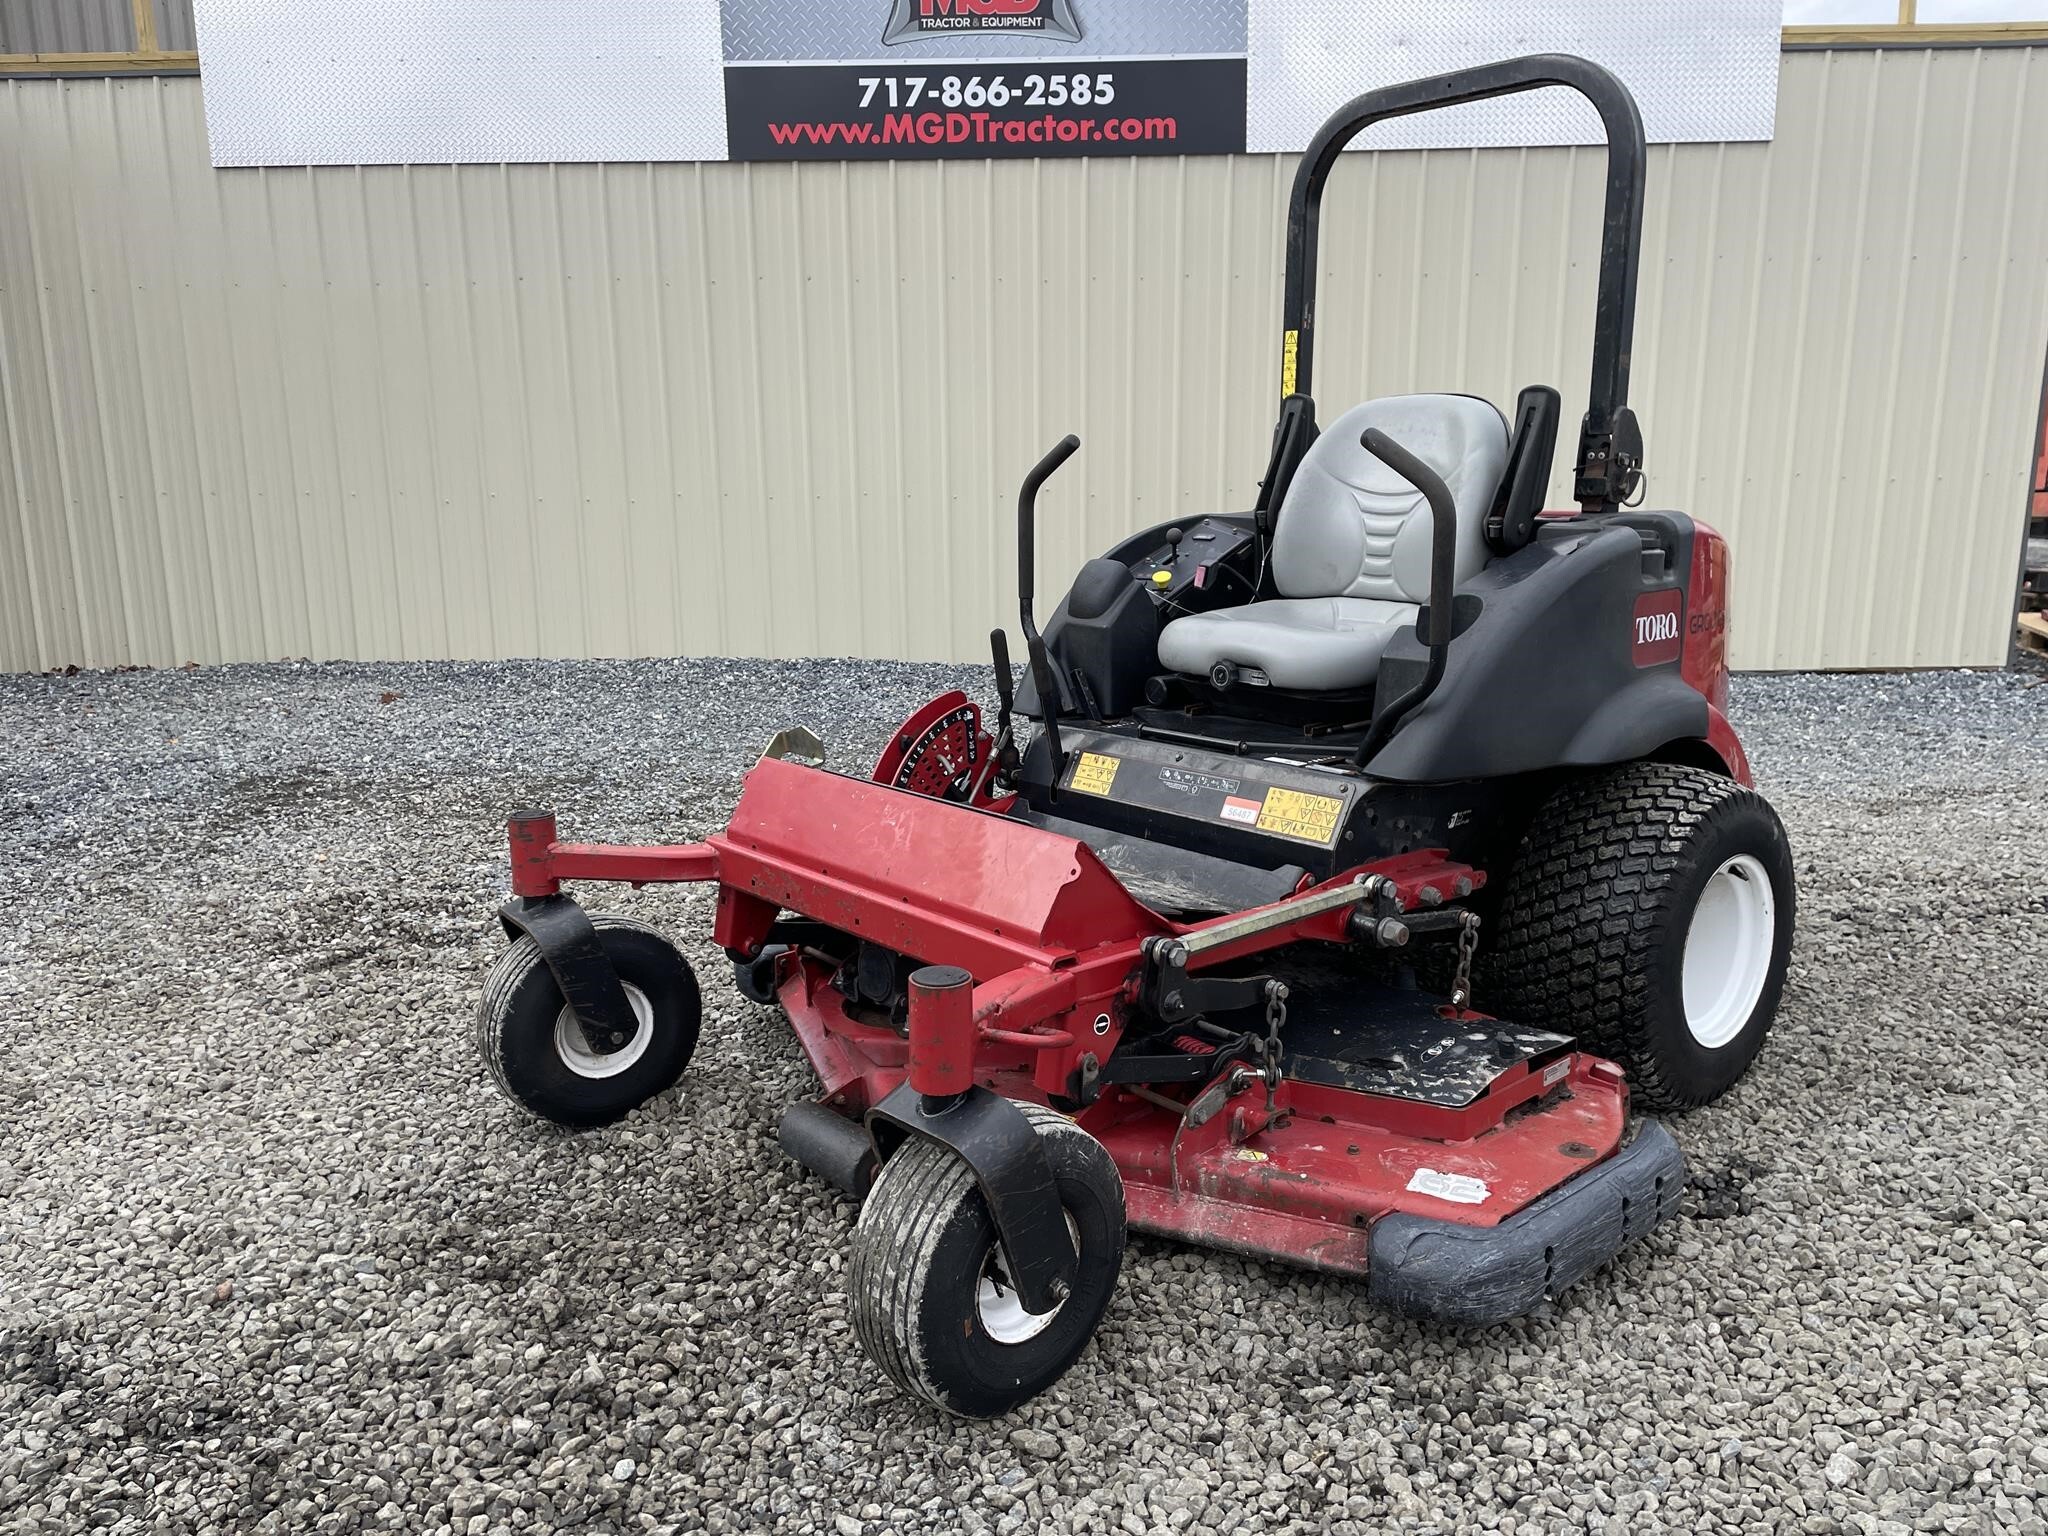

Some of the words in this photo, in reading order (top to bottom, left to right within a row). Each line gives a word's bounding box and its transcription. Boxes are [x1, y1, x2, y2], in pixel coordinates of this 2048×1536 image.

[921, 17, 970, 28] TRACTOR
[972, 17, 979, 27] &
[981, 17, 1043, 28] EQUIPMENT
[858, 74, 1115, 108] 717-866-2585
[768, 113, 1177, 145] www.MGDTractor.com
